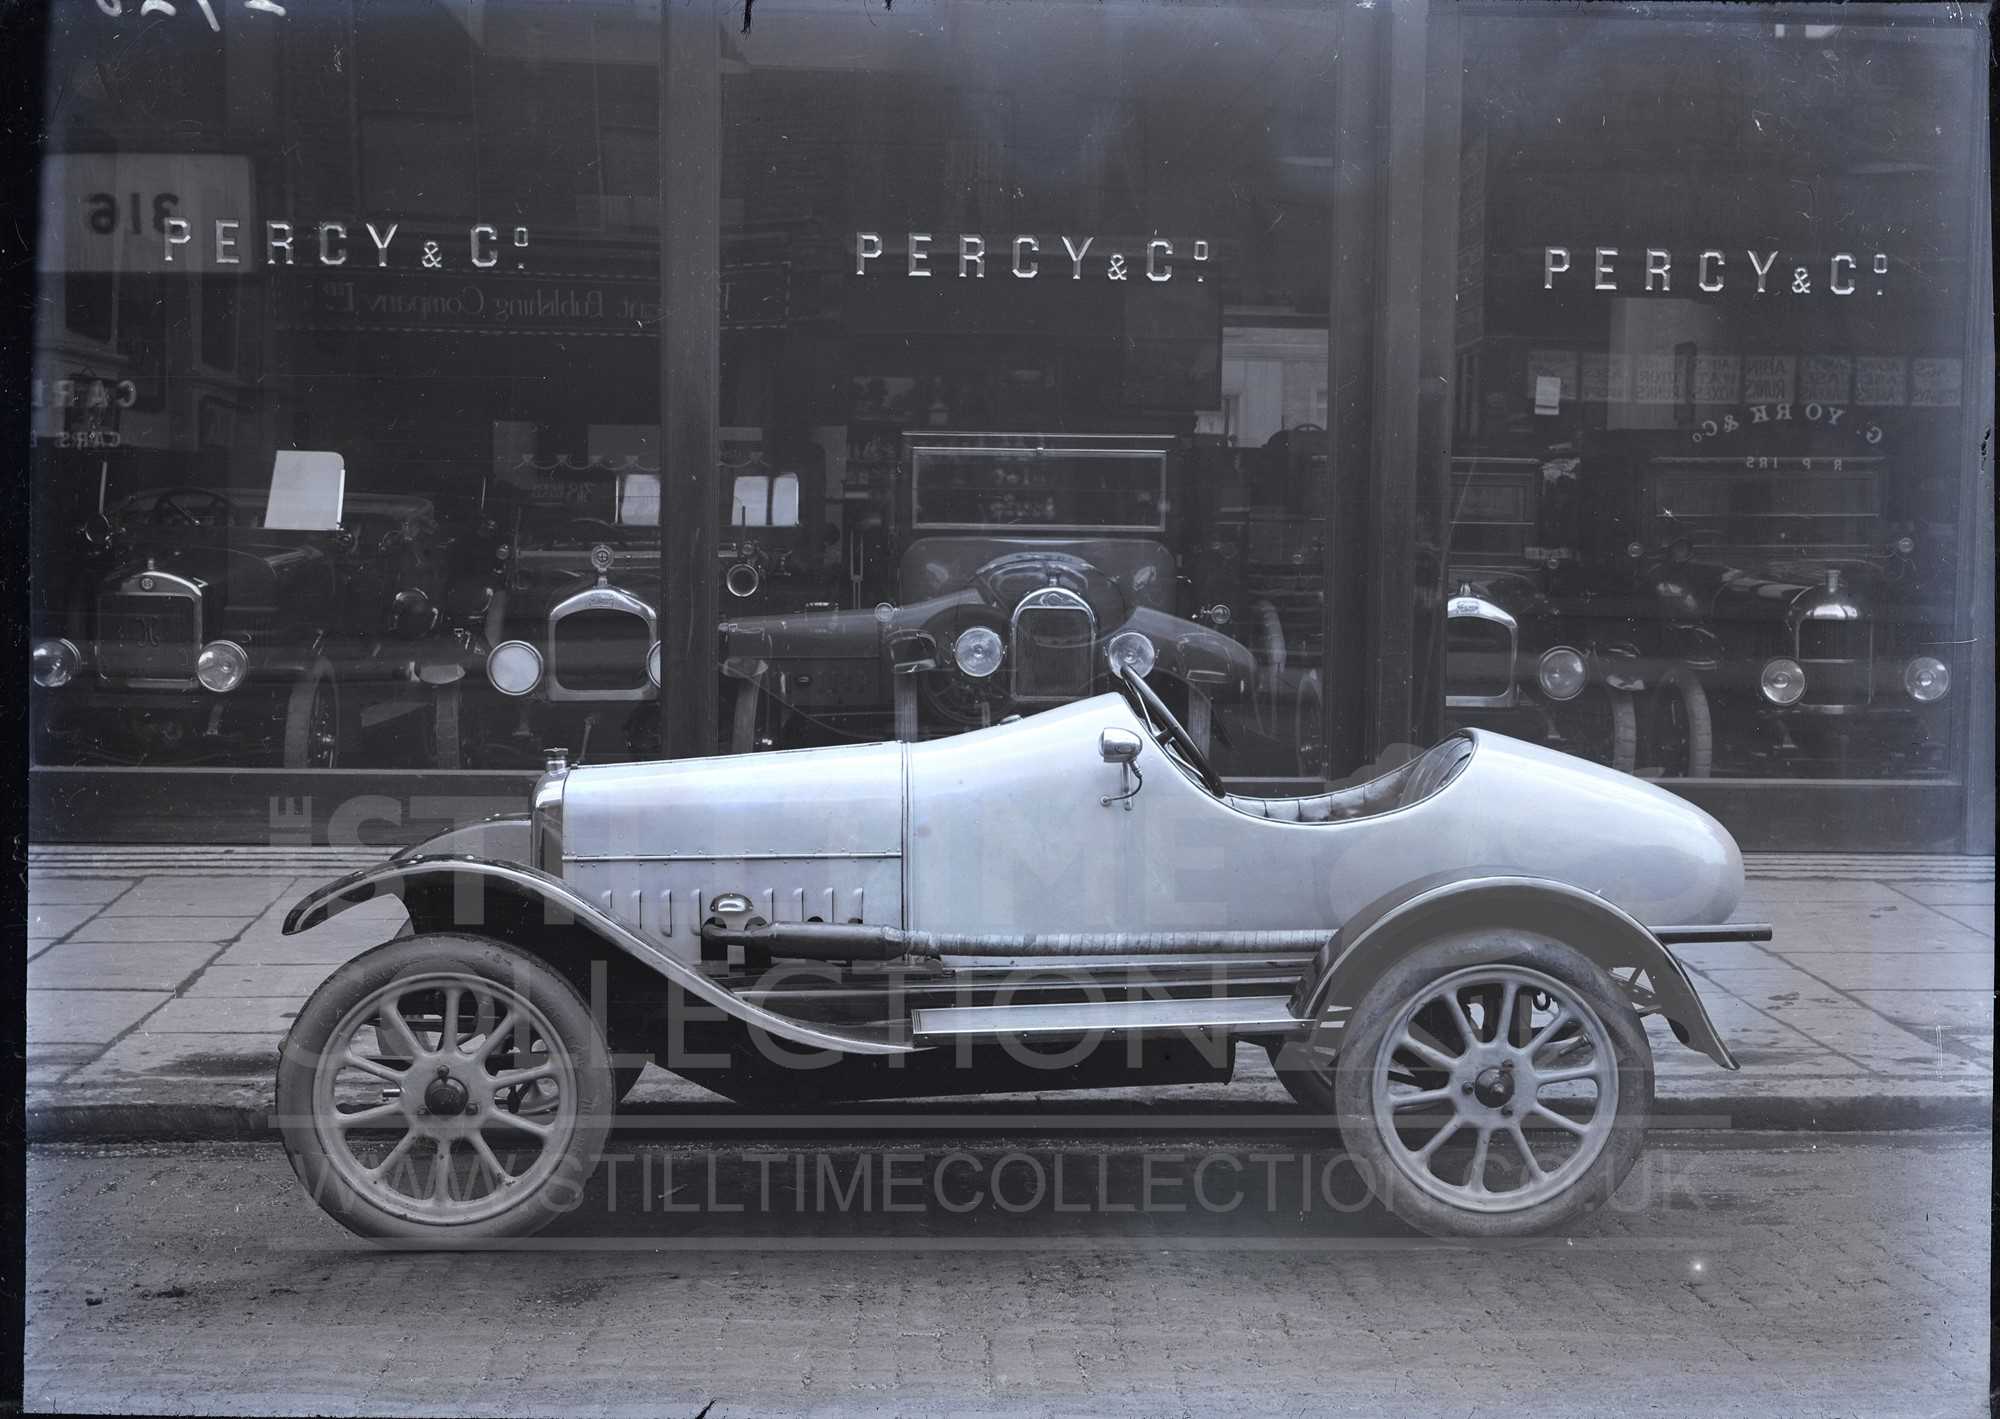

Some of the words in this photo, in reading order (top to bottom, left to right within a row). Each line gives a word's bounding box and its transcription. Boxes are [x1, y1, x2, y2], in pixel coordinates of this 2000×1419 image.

[163, 217, 399, 268] PERCY
[421, 241, 442, 268] &
[856, 231, 1094, 280] PERCY
[1107, 253, 1127, 281] &
[1543, 246, 1779, 293] PERCY
[1791, 266, 1811, 294] &
